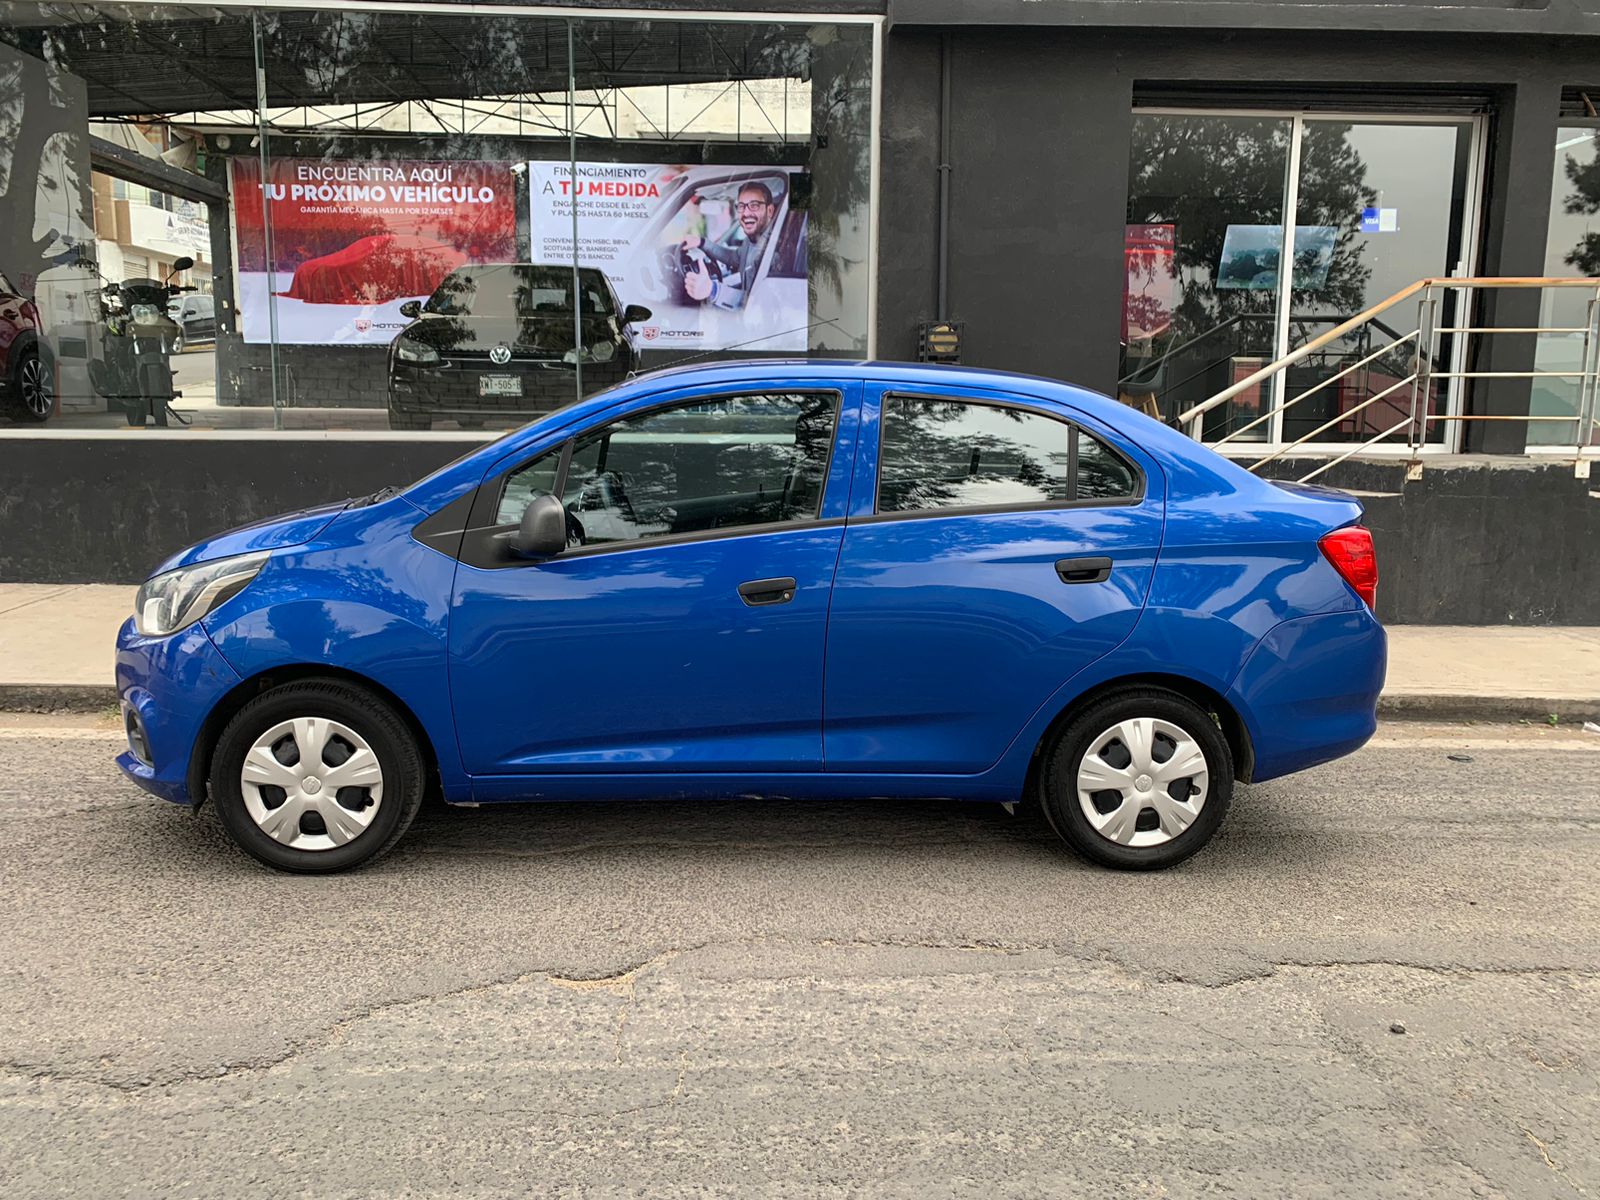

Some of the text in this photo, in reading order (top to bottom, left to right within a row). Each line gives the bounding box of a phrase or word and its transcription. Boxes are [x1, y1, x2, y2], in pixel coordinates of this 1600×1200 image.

[298, 165, 452, 183] ENCUENTRA AQUÍ
[291, 181, 387, 202] PRÓXIMO
[389, 182, 495, 204] VEHÍCULO
[542, 180, 660, 198] A TU MEDIDA
[300, 205, 338, 214] GARANTÍA
[379, 207, 403, 215] HASTA
[405, 207, 421, 215] POR
[421, 207, 429, 215] 12
[430, 207, 454, 216] MESES
[596, 201, 619, 209] DESDE
[631, 202, 647, 210] 20%
[551, 209, 556, 217] Y
[587, 210, 612, 218] HASTA
